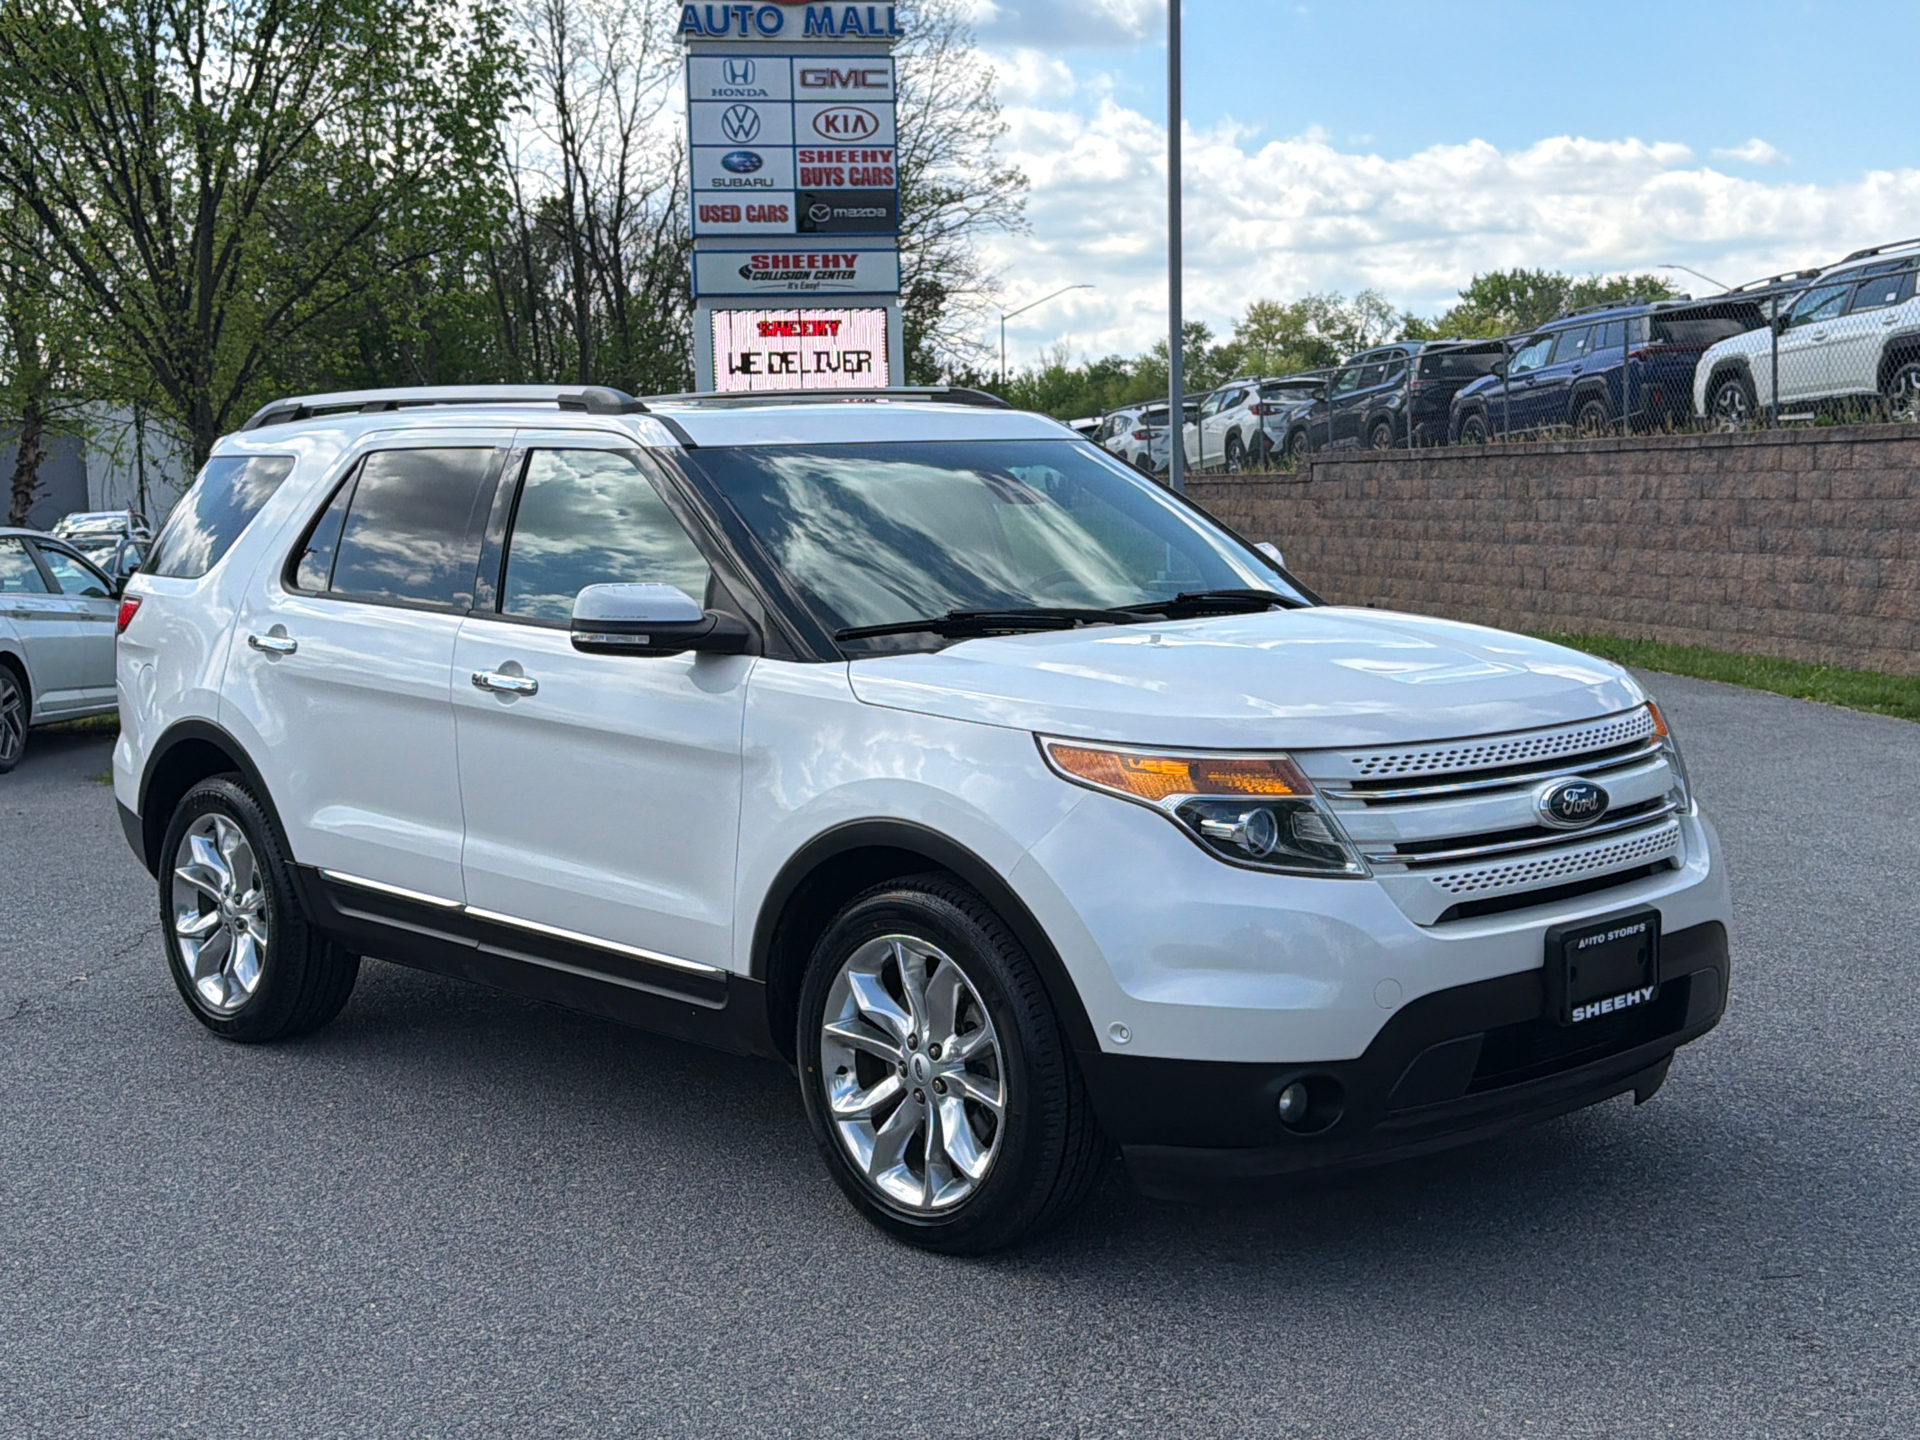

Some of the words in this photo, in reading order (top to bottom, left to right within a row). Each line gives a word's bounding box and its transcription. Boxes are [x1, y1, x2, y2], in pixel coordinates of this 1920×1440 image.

[679, 4, 784, 35] AUTO
[803, 6, 905, 37] MALL
[800, 69, 889, 89] GMC
[711, 88, 769, 98] HONDA
[824, 114, 869, 134] KIA
[799, 150, 894, 163] SHEEHY
[711, 178, 774, 188] SUBARU
[800, 167, 844, 187] BUYS
[849, 167, 894, 187] CARS
[698, 204, 741, 223] USED
[746, 204, 789, 223] CARS
[833, 208, 887, 218] mazda
[751, 254, 859, 269] SHEEHY
[752, 270, 811, 281] COLLISION
[814, 269, 856, 280] CENTER
[757, 320, 841, 337] SHEEHY
[728, 350, 762, 374] WE
[768, 350, 871, 374] DELIVER
[1562, 787, 1599, 815] Ford
[1577, 931, 1605, 950] AUTO
[1572, 986, 1654, 1023] SHEEHY
